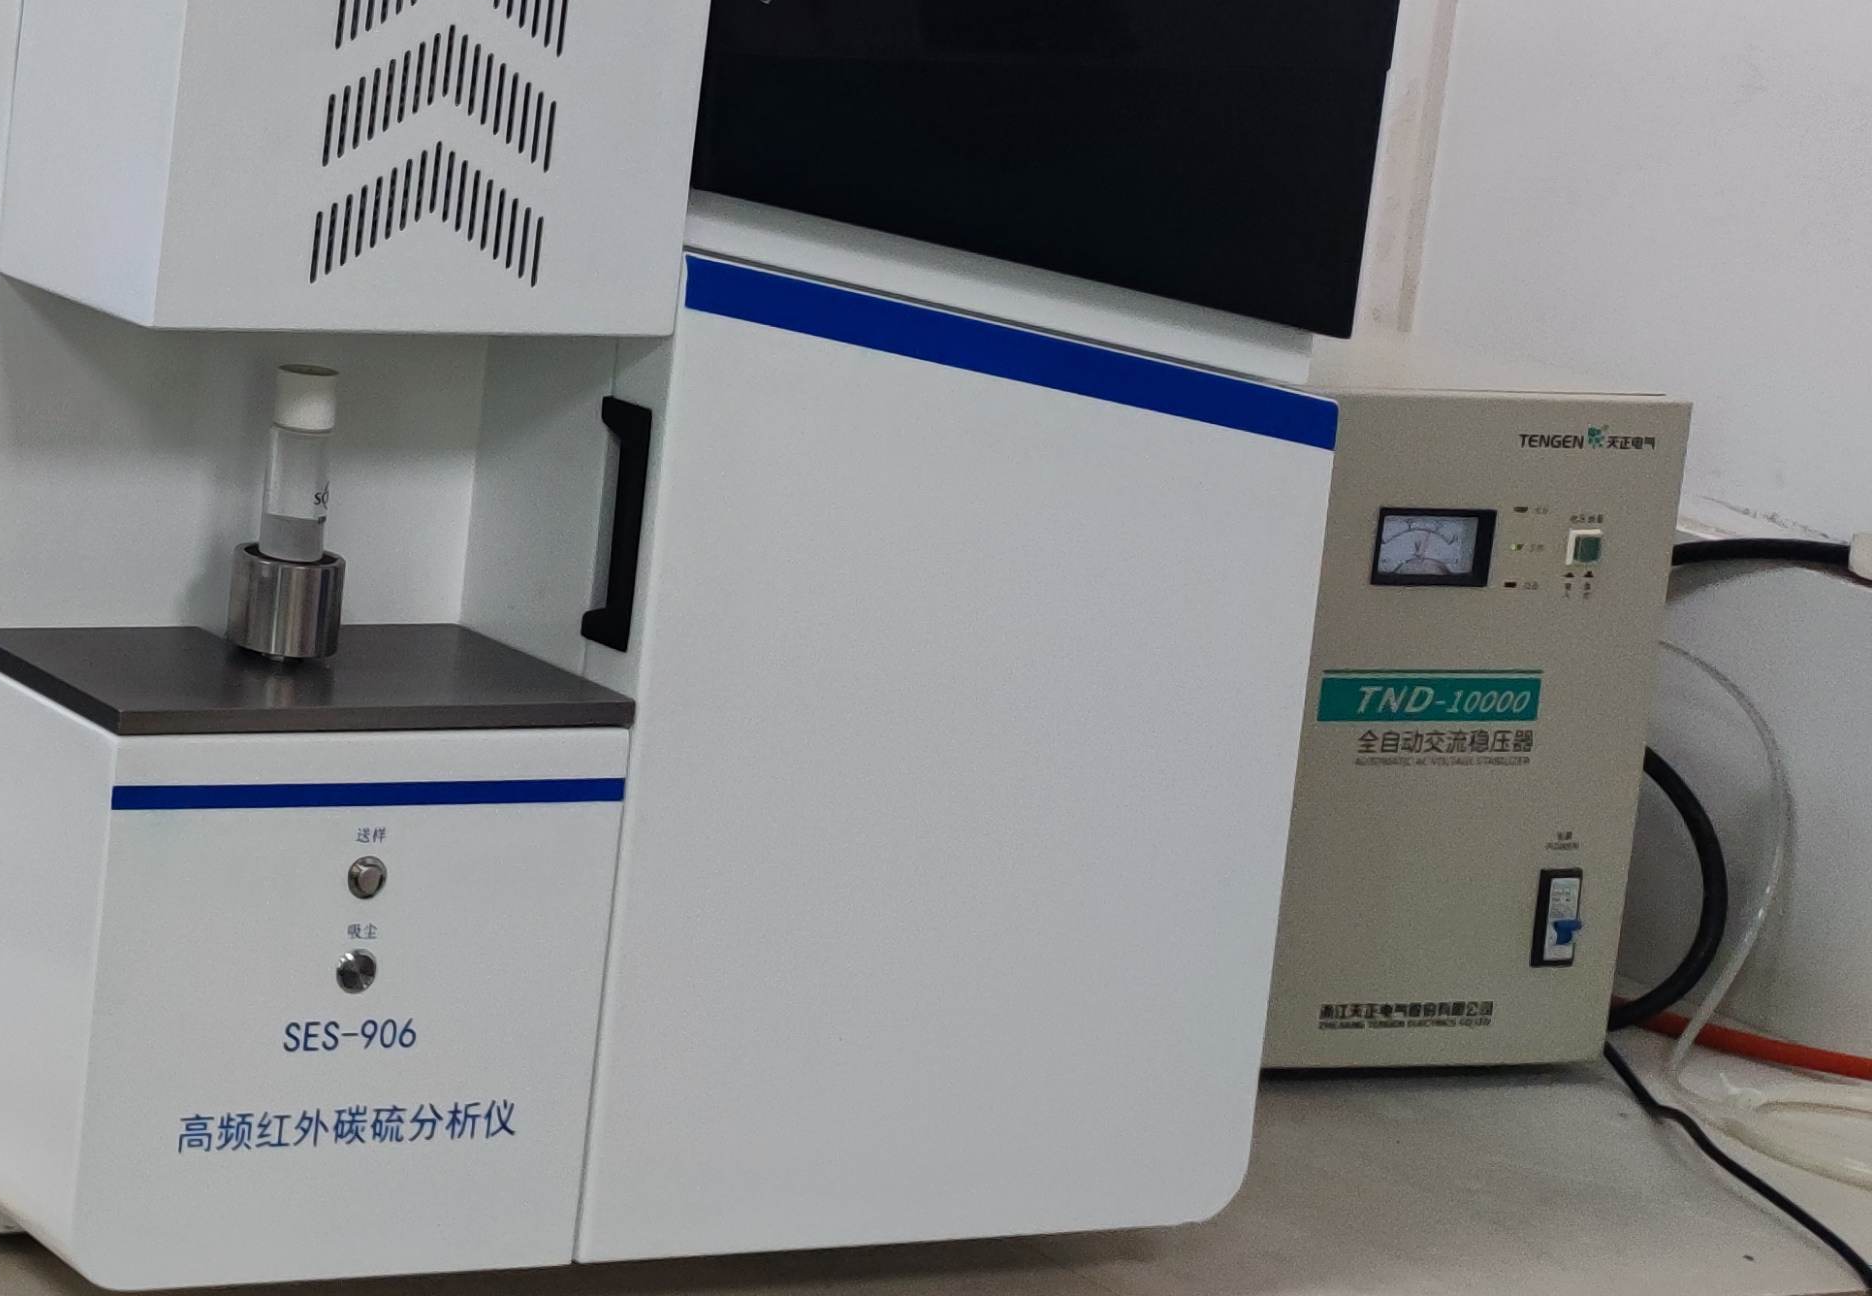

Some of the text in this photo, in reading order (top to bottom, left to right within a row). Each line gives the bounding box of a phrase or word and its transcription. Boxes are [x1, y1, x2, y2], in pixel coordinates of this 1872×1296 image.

[1519, 433, 1584, 449] TENGEN
[1357, 685, 1531, 714] TND-10000
[1357, 729, 1534, 754] 全自动交流稳压器
[356, 826, 386, 844] 送样
[347, 922, 378, 940] 吸尘
[283, 1018, 417, 1052] SES-906
[177, 1099, 516, 1154] 高频红外碳硫分析仪
